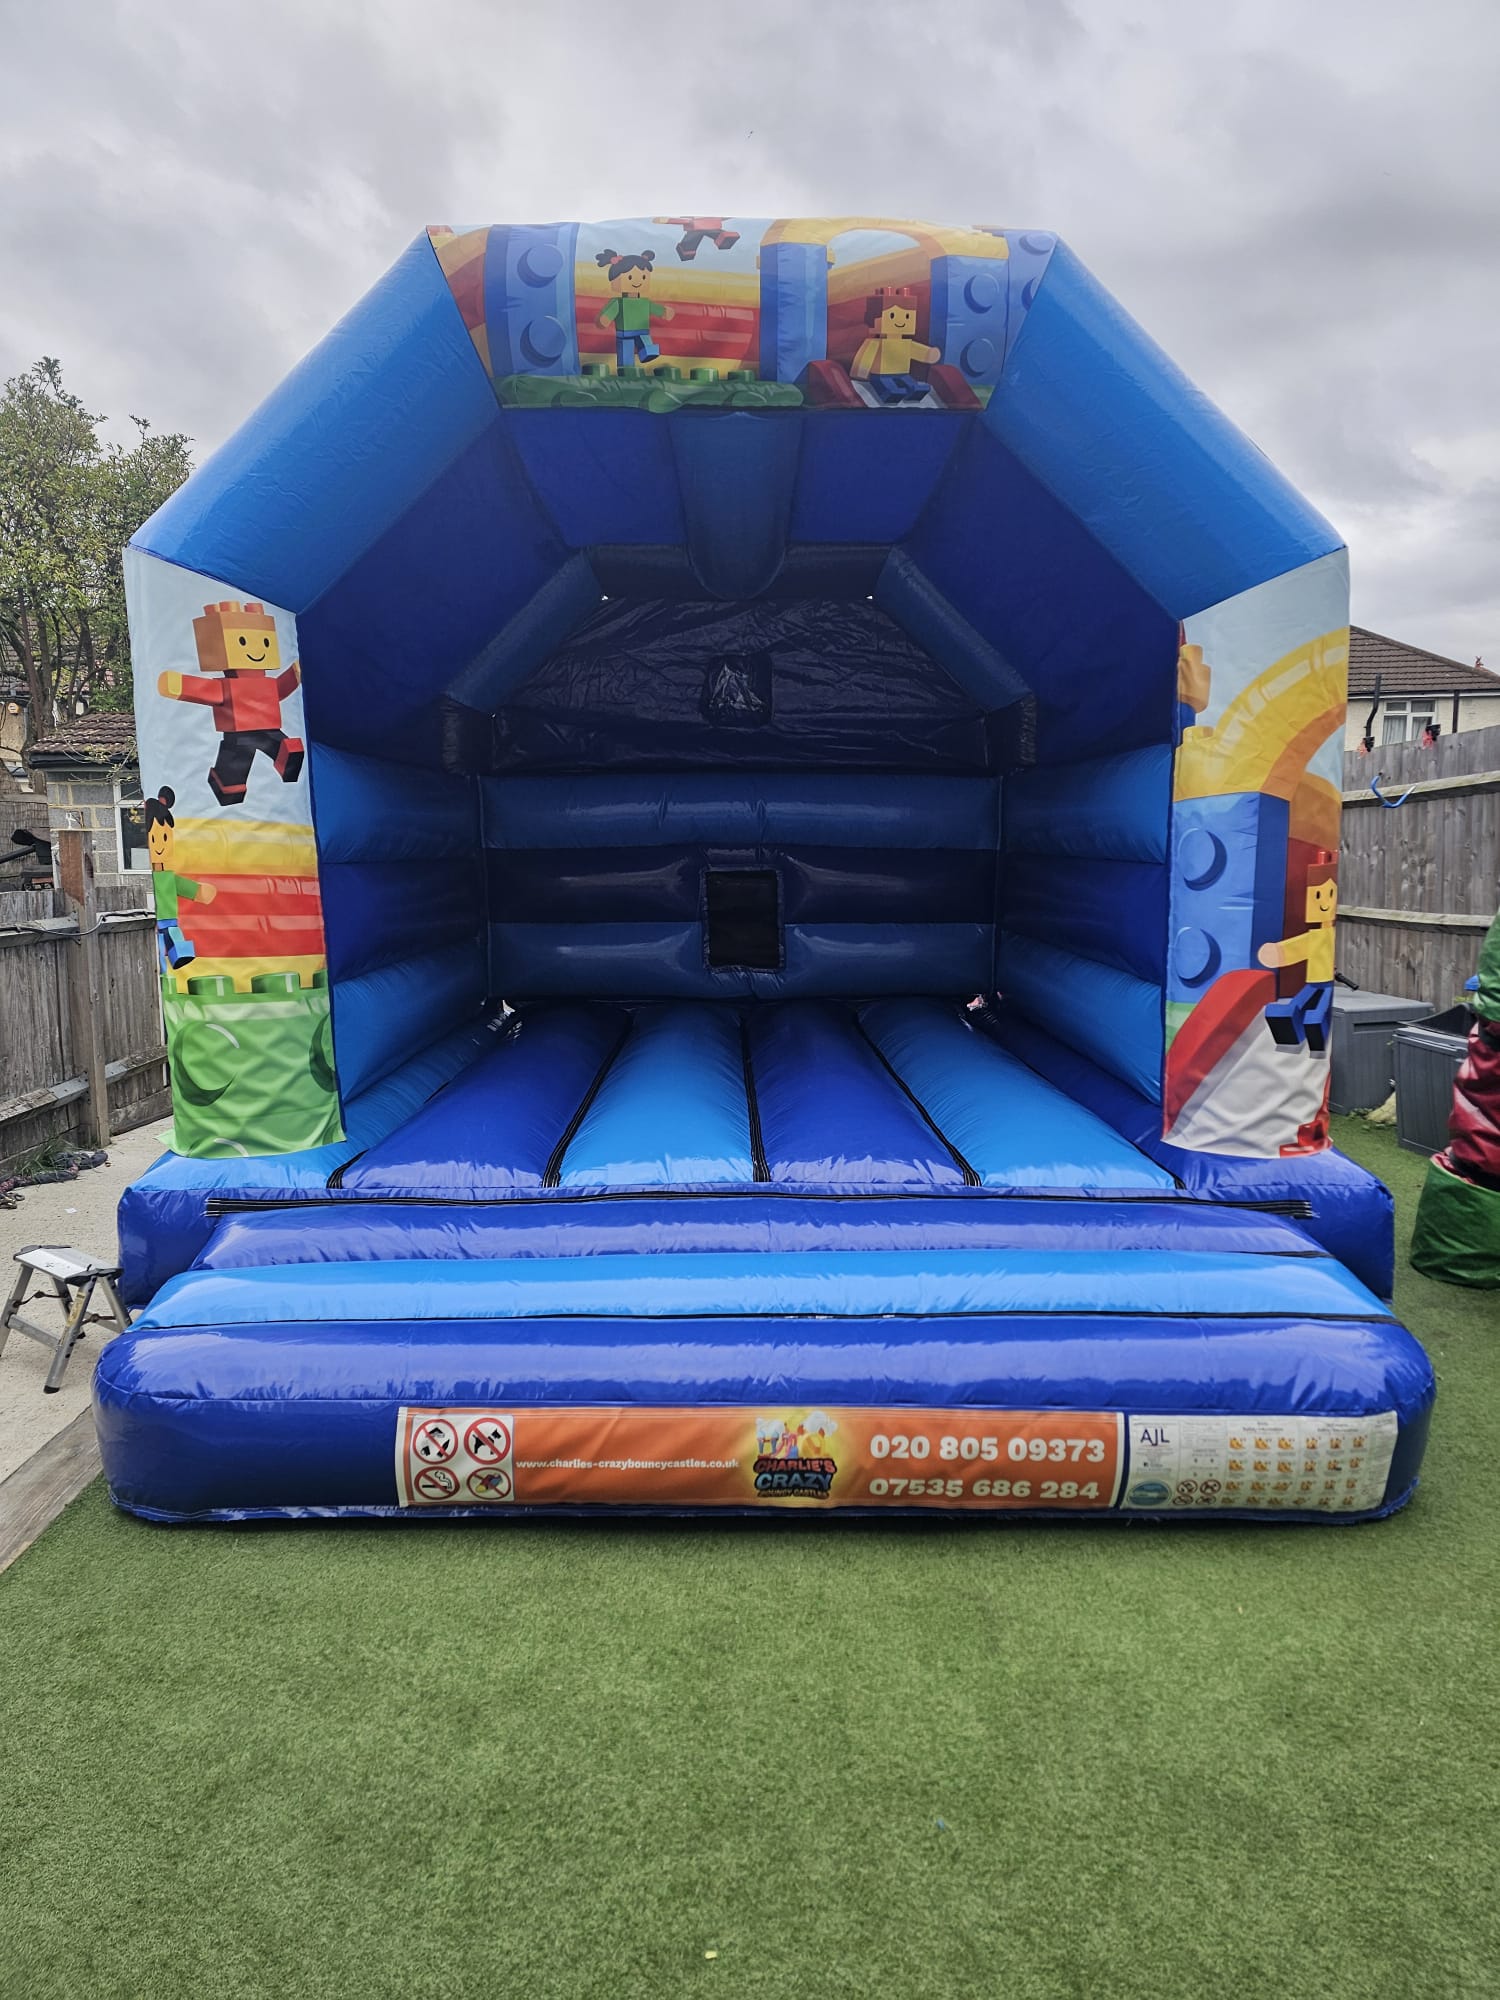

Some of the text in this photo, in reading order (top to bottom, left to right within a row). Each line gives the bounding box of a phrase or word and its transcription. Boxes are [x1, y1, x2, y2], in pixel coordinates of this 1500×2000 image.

[1140, 1428, 1170, 1446] AJL
[870, 1435, 1105, 1462] 020 805 09373
[516, 1458, 739, 1471] www.charlies-crazybouncycastles.co.uk
[754, 1458, 837, 1473] CHARLIE'S
[756, 1472, 832, 1491] CRAZY
[869, 1478, 1100, 1499] 07535 686 284
